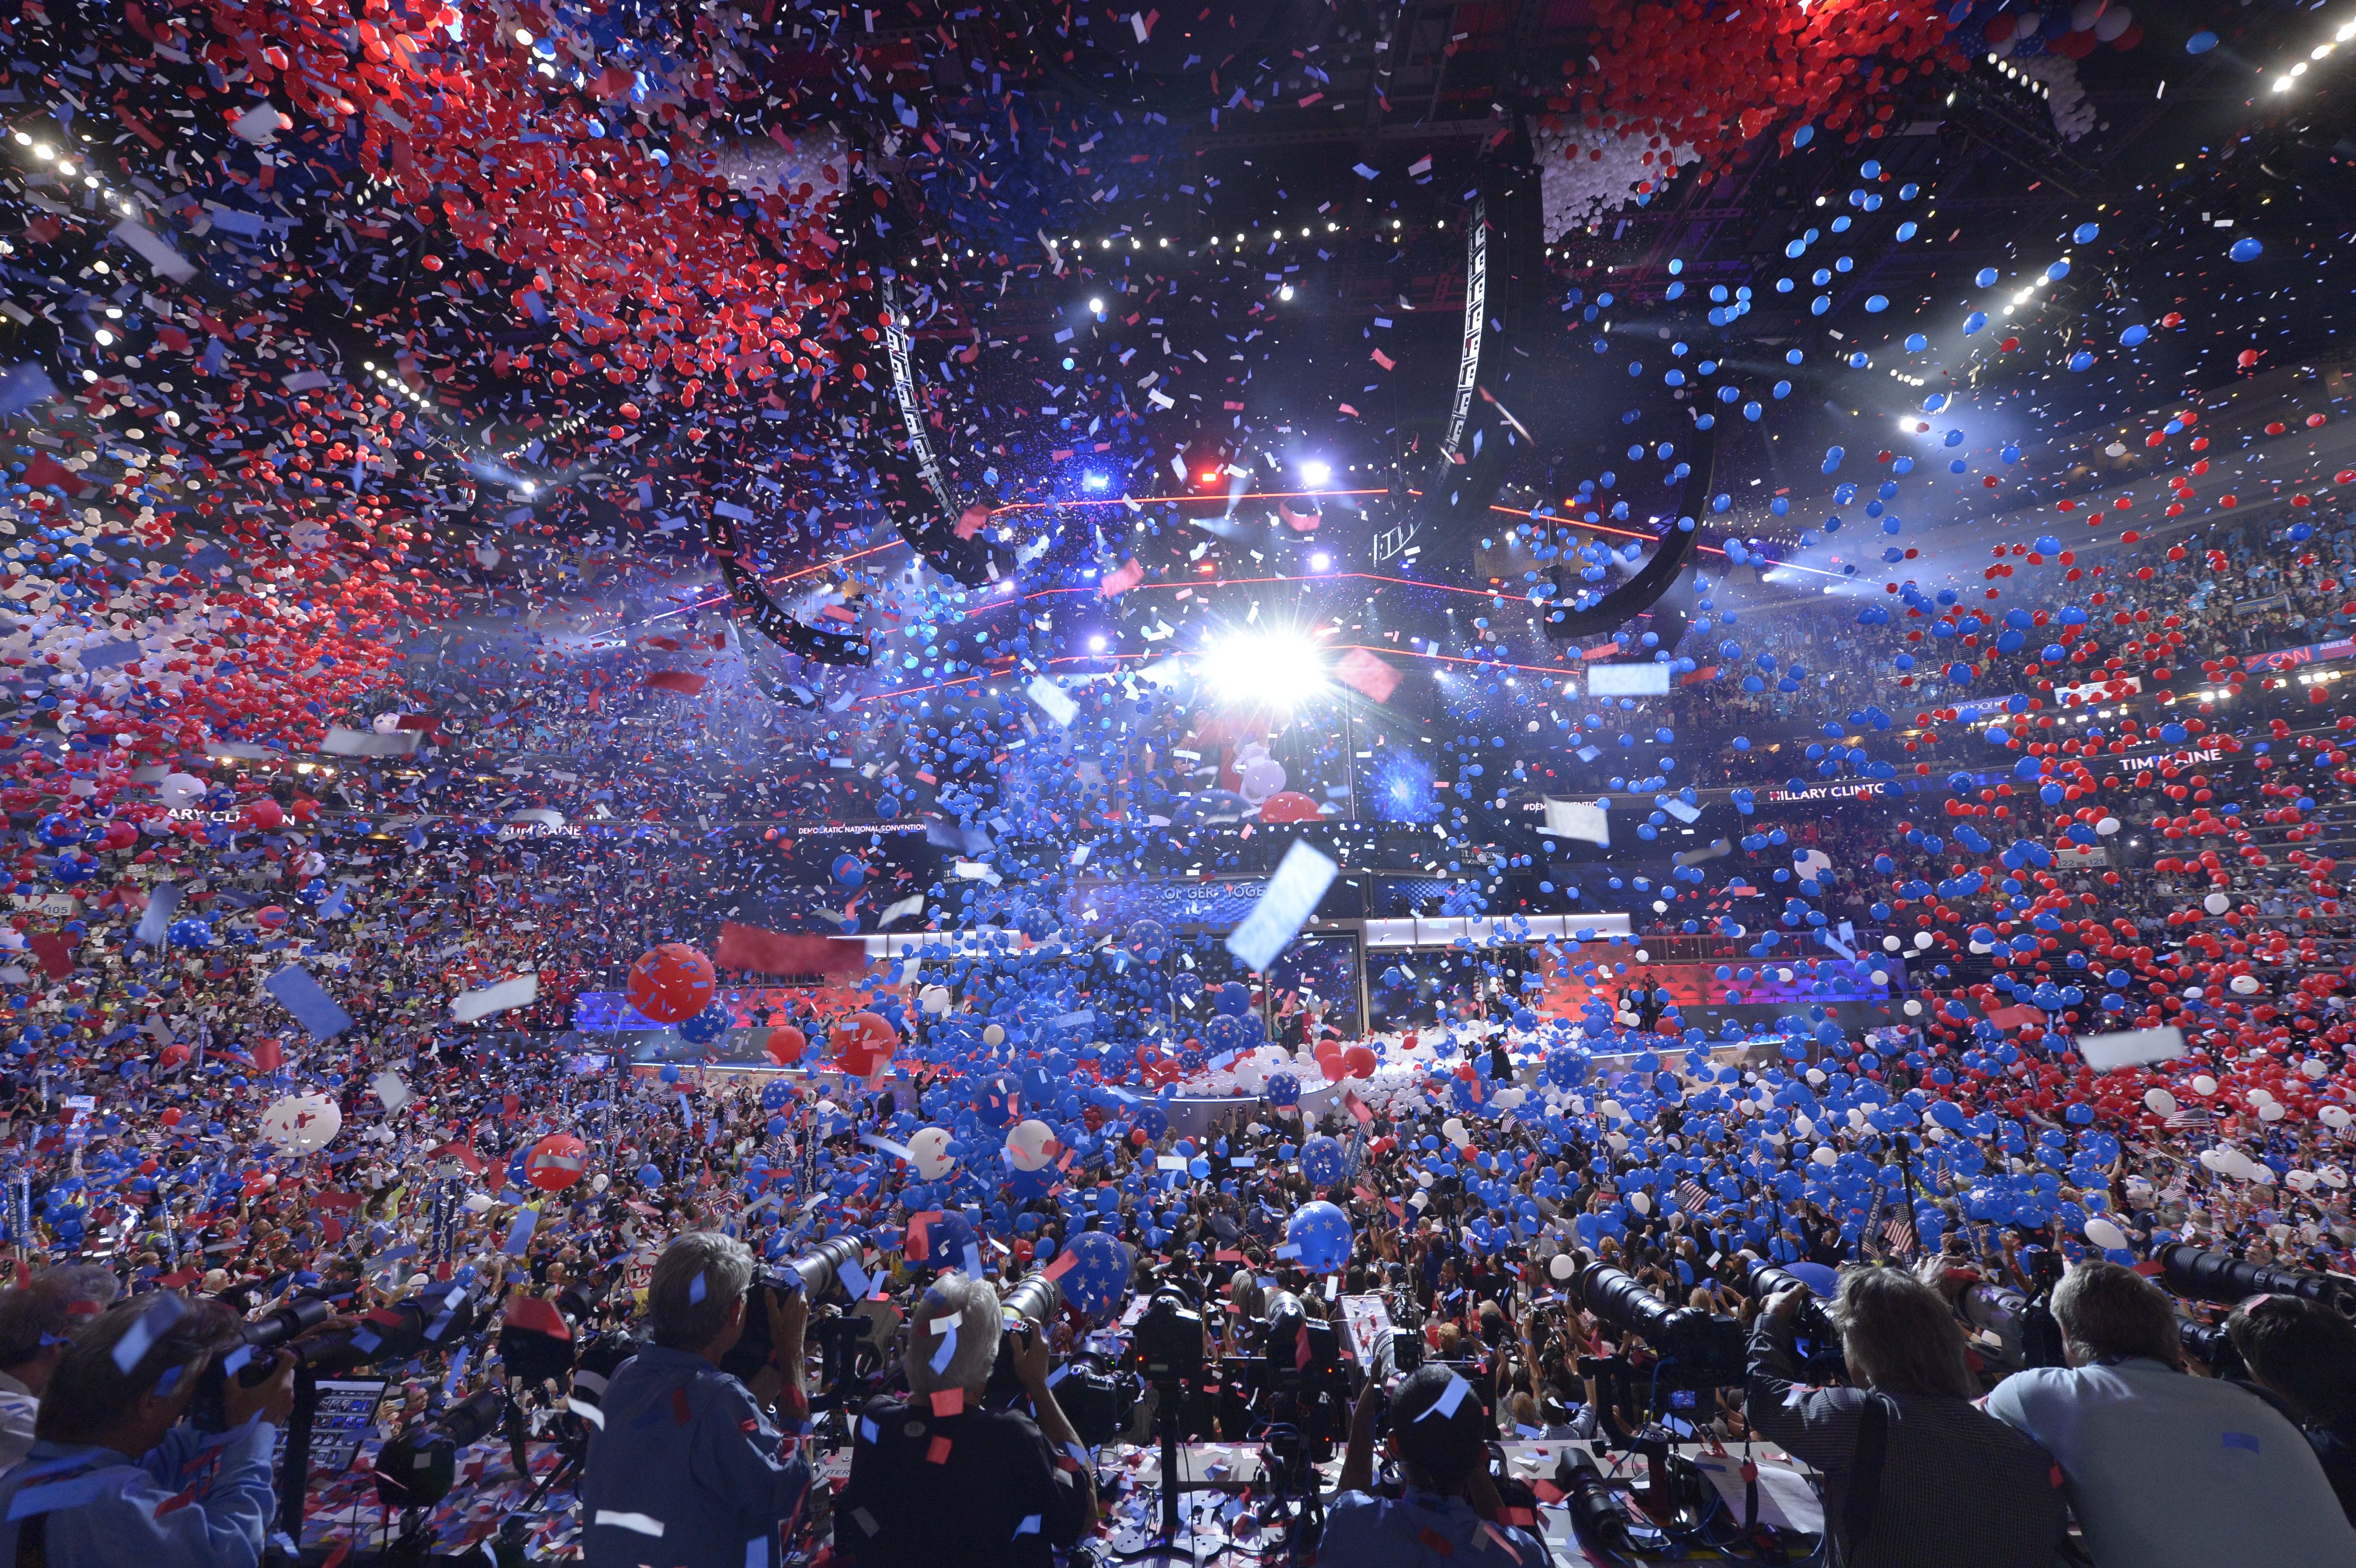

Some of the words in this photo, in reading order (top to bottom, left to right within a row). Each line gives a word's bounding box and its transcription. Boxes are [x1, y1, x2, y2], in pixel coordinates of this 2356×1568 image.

[2320, 639, 2353, 651] AMERI
[2118, 757, 2154, 771] TIM
[844, 825, 879, 833] NATIONAL
[1227, 887, 1267, 898] TOGE
[805, 1126, 815, 1194] VIRGINIA
[1865, 1187, 1885, 1236] STRONG
